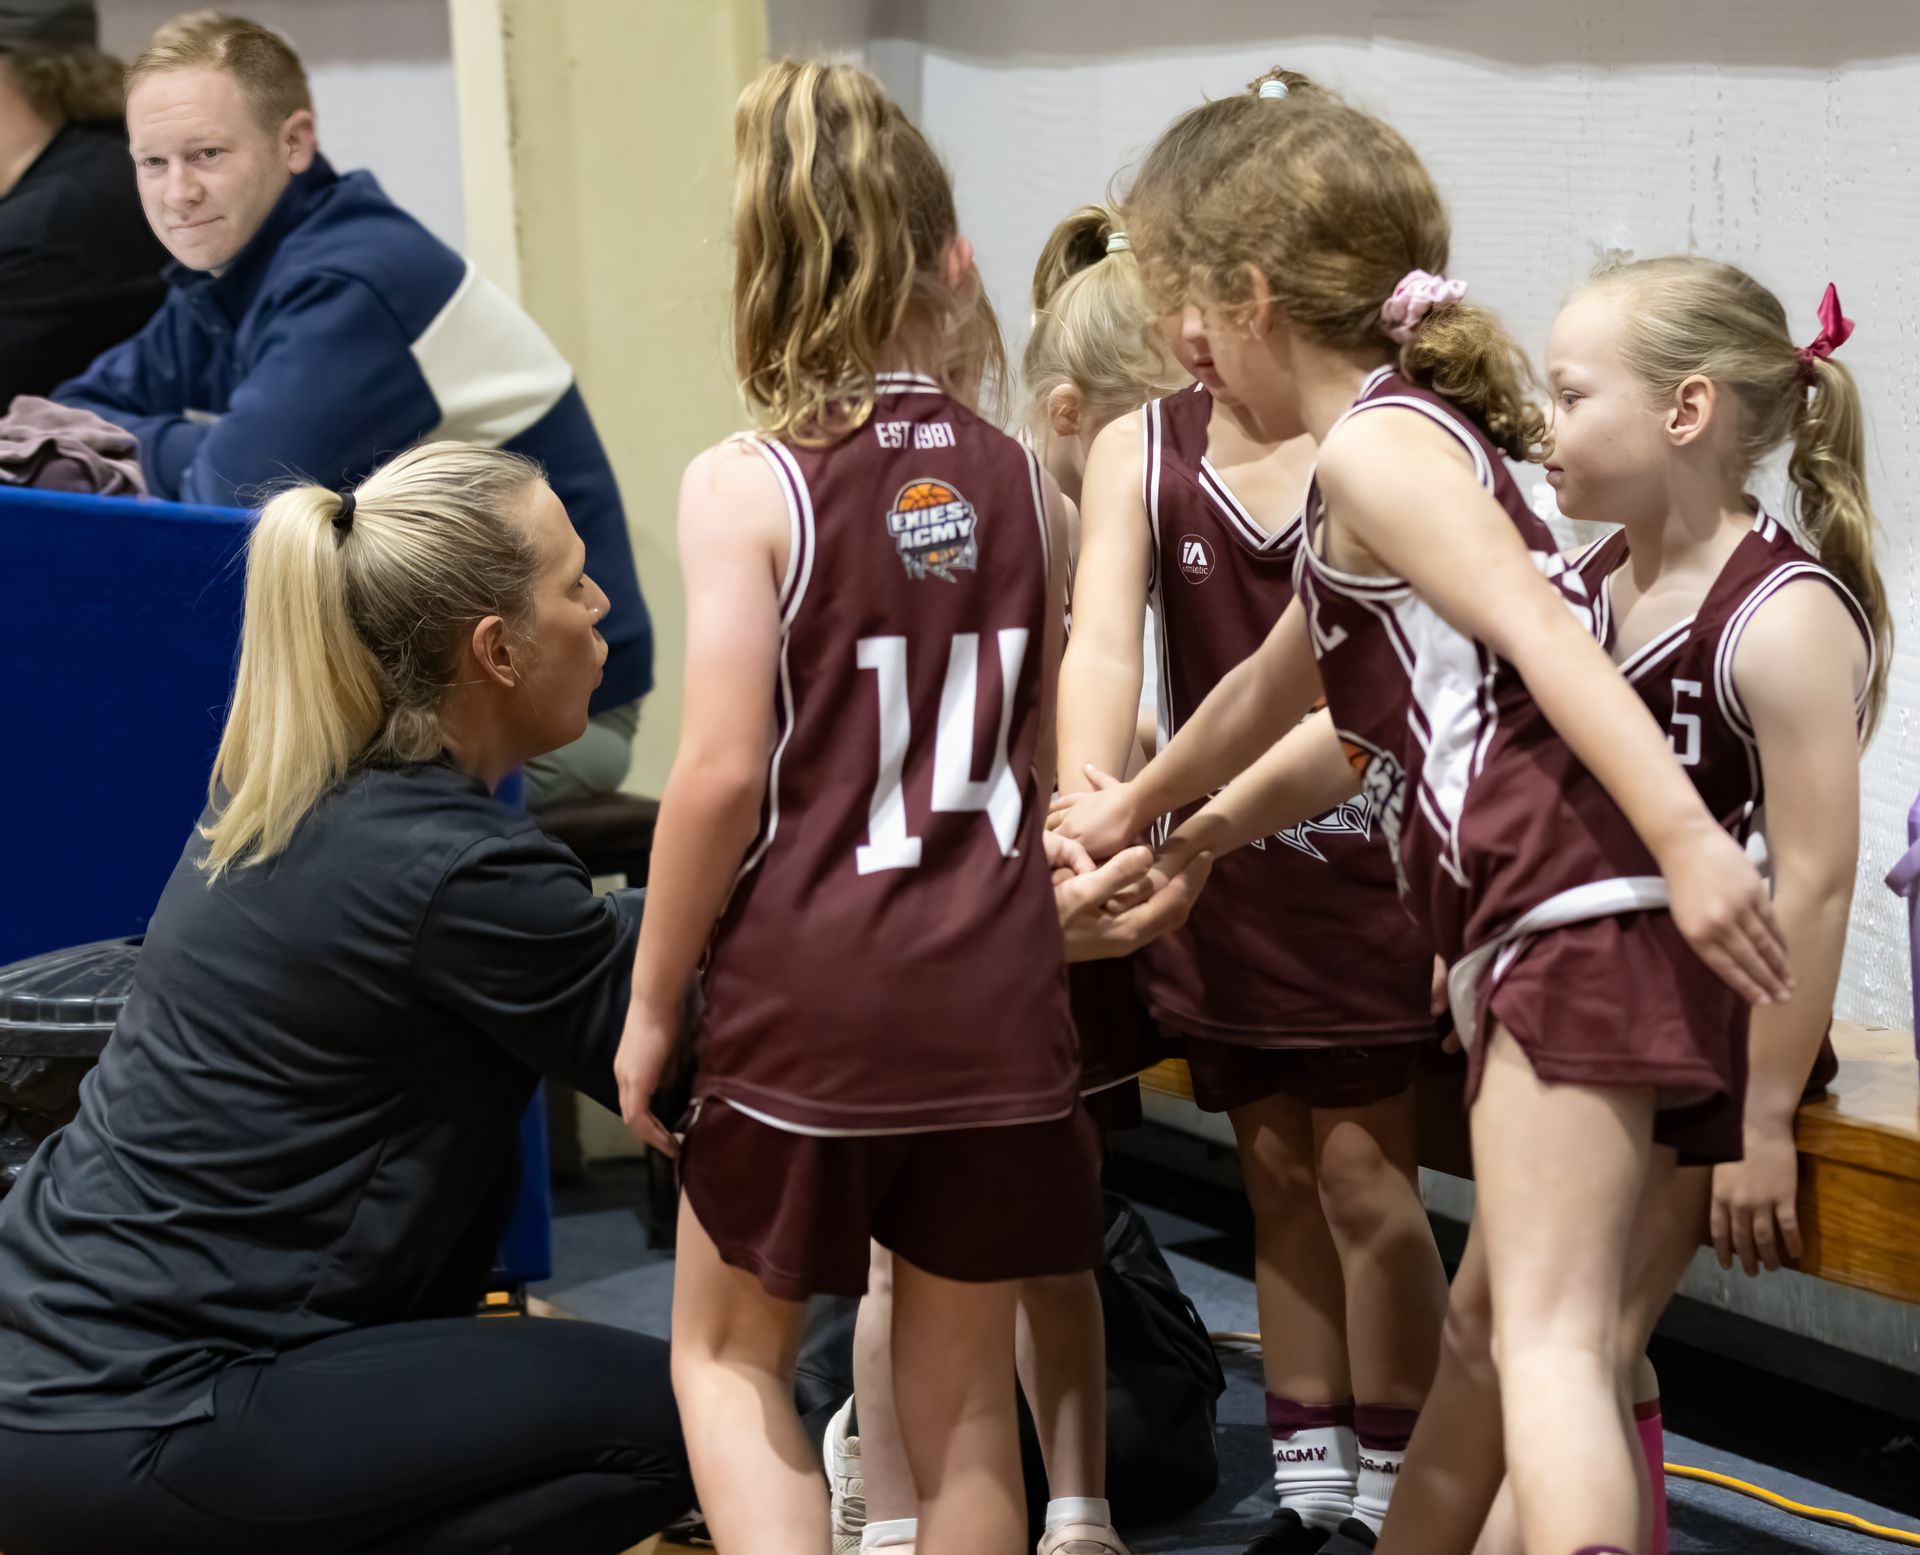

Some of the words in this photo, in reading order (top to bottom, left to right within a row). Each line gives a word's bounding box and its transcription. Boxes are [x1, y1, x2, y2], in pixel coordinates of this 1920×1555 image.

[874, 421, 912, 449] EST
[914, 422, 956, 450] 1981
[900, 518, 972, 550] ACMY
[856, 627, 1029, 875] 14
